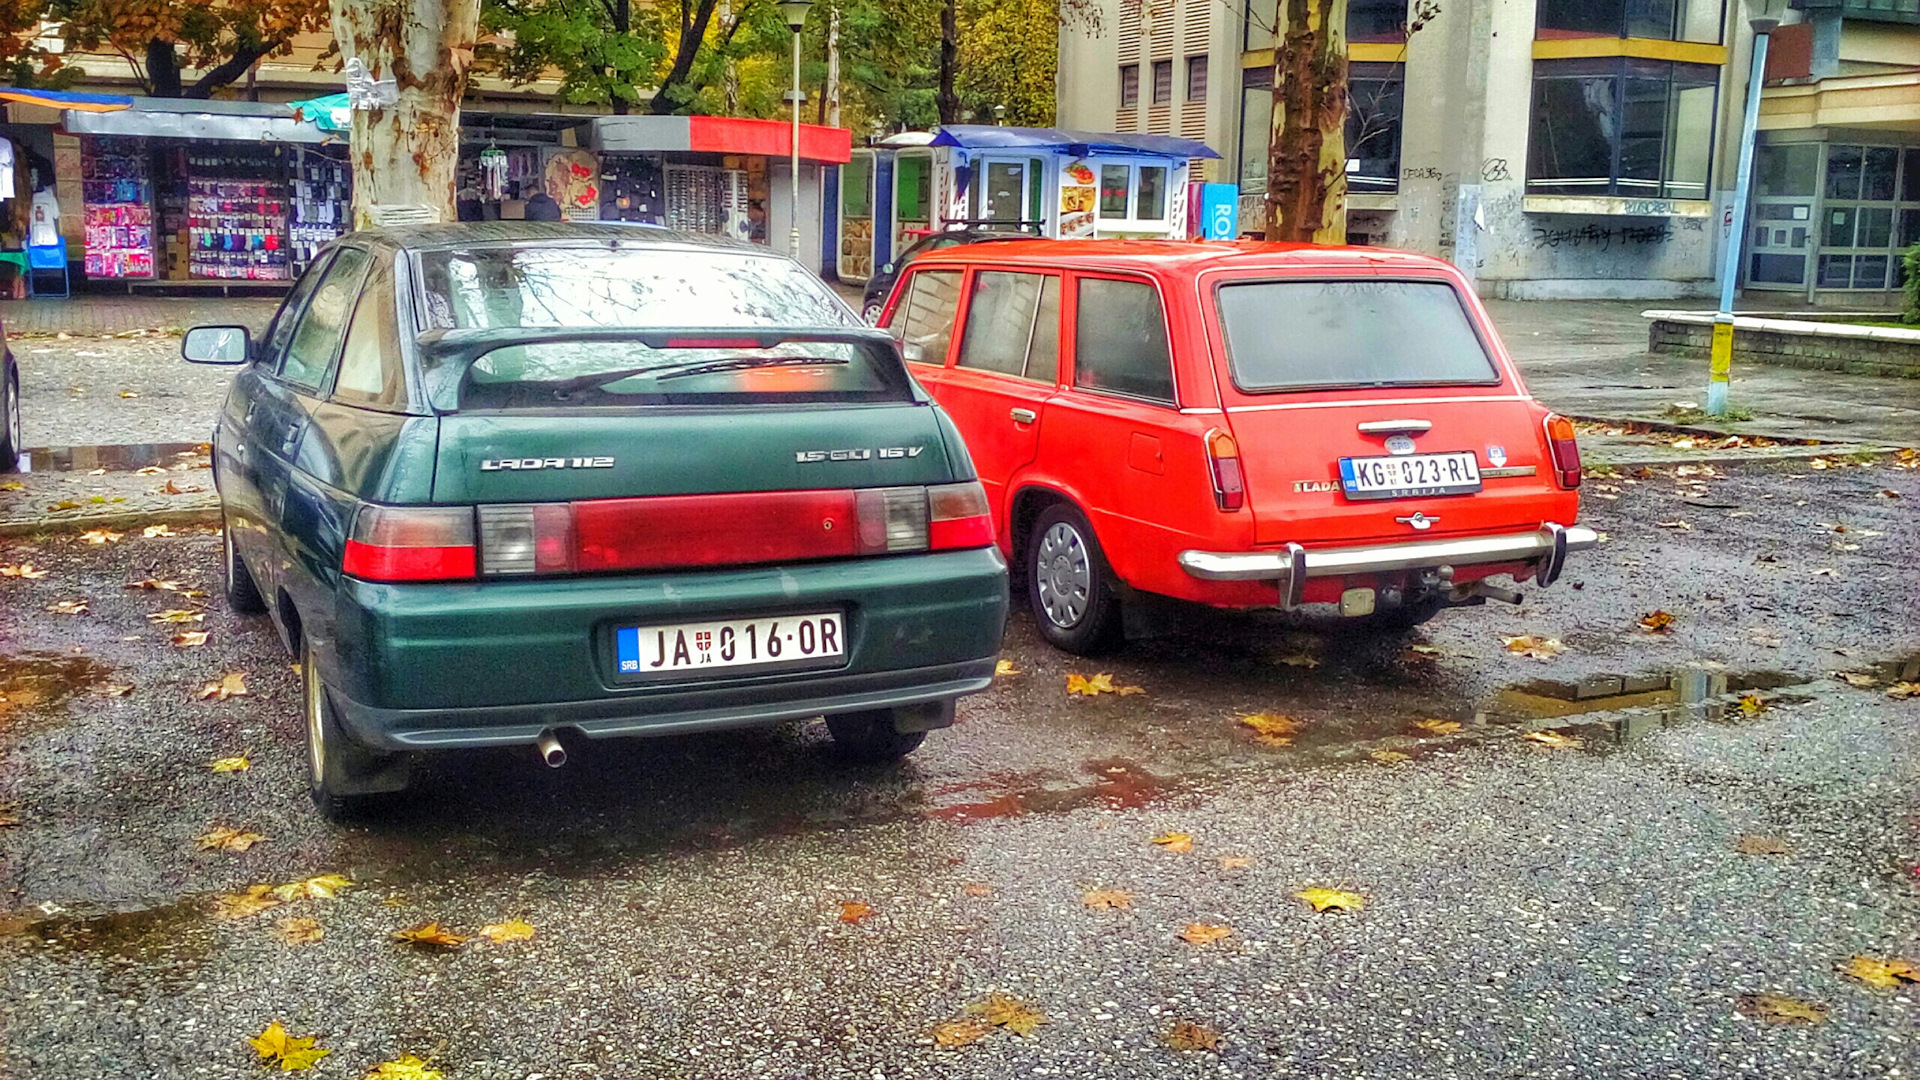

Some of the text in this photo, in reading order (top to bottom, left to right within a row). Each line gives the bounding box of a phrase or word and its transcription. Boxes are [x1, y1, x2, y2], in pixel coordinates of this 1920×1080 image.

[1214, 204, 1232, 240] RO
[1391, 441, 1410, 450] SRB
[481, 457, 615, 471] LADA 112
[1357, 462, 1385, 487] KG
[1302, 480, 1340, 492] LADA
[650, 629, 691, 668] JA
[621, 660, 638, 671] SRB
